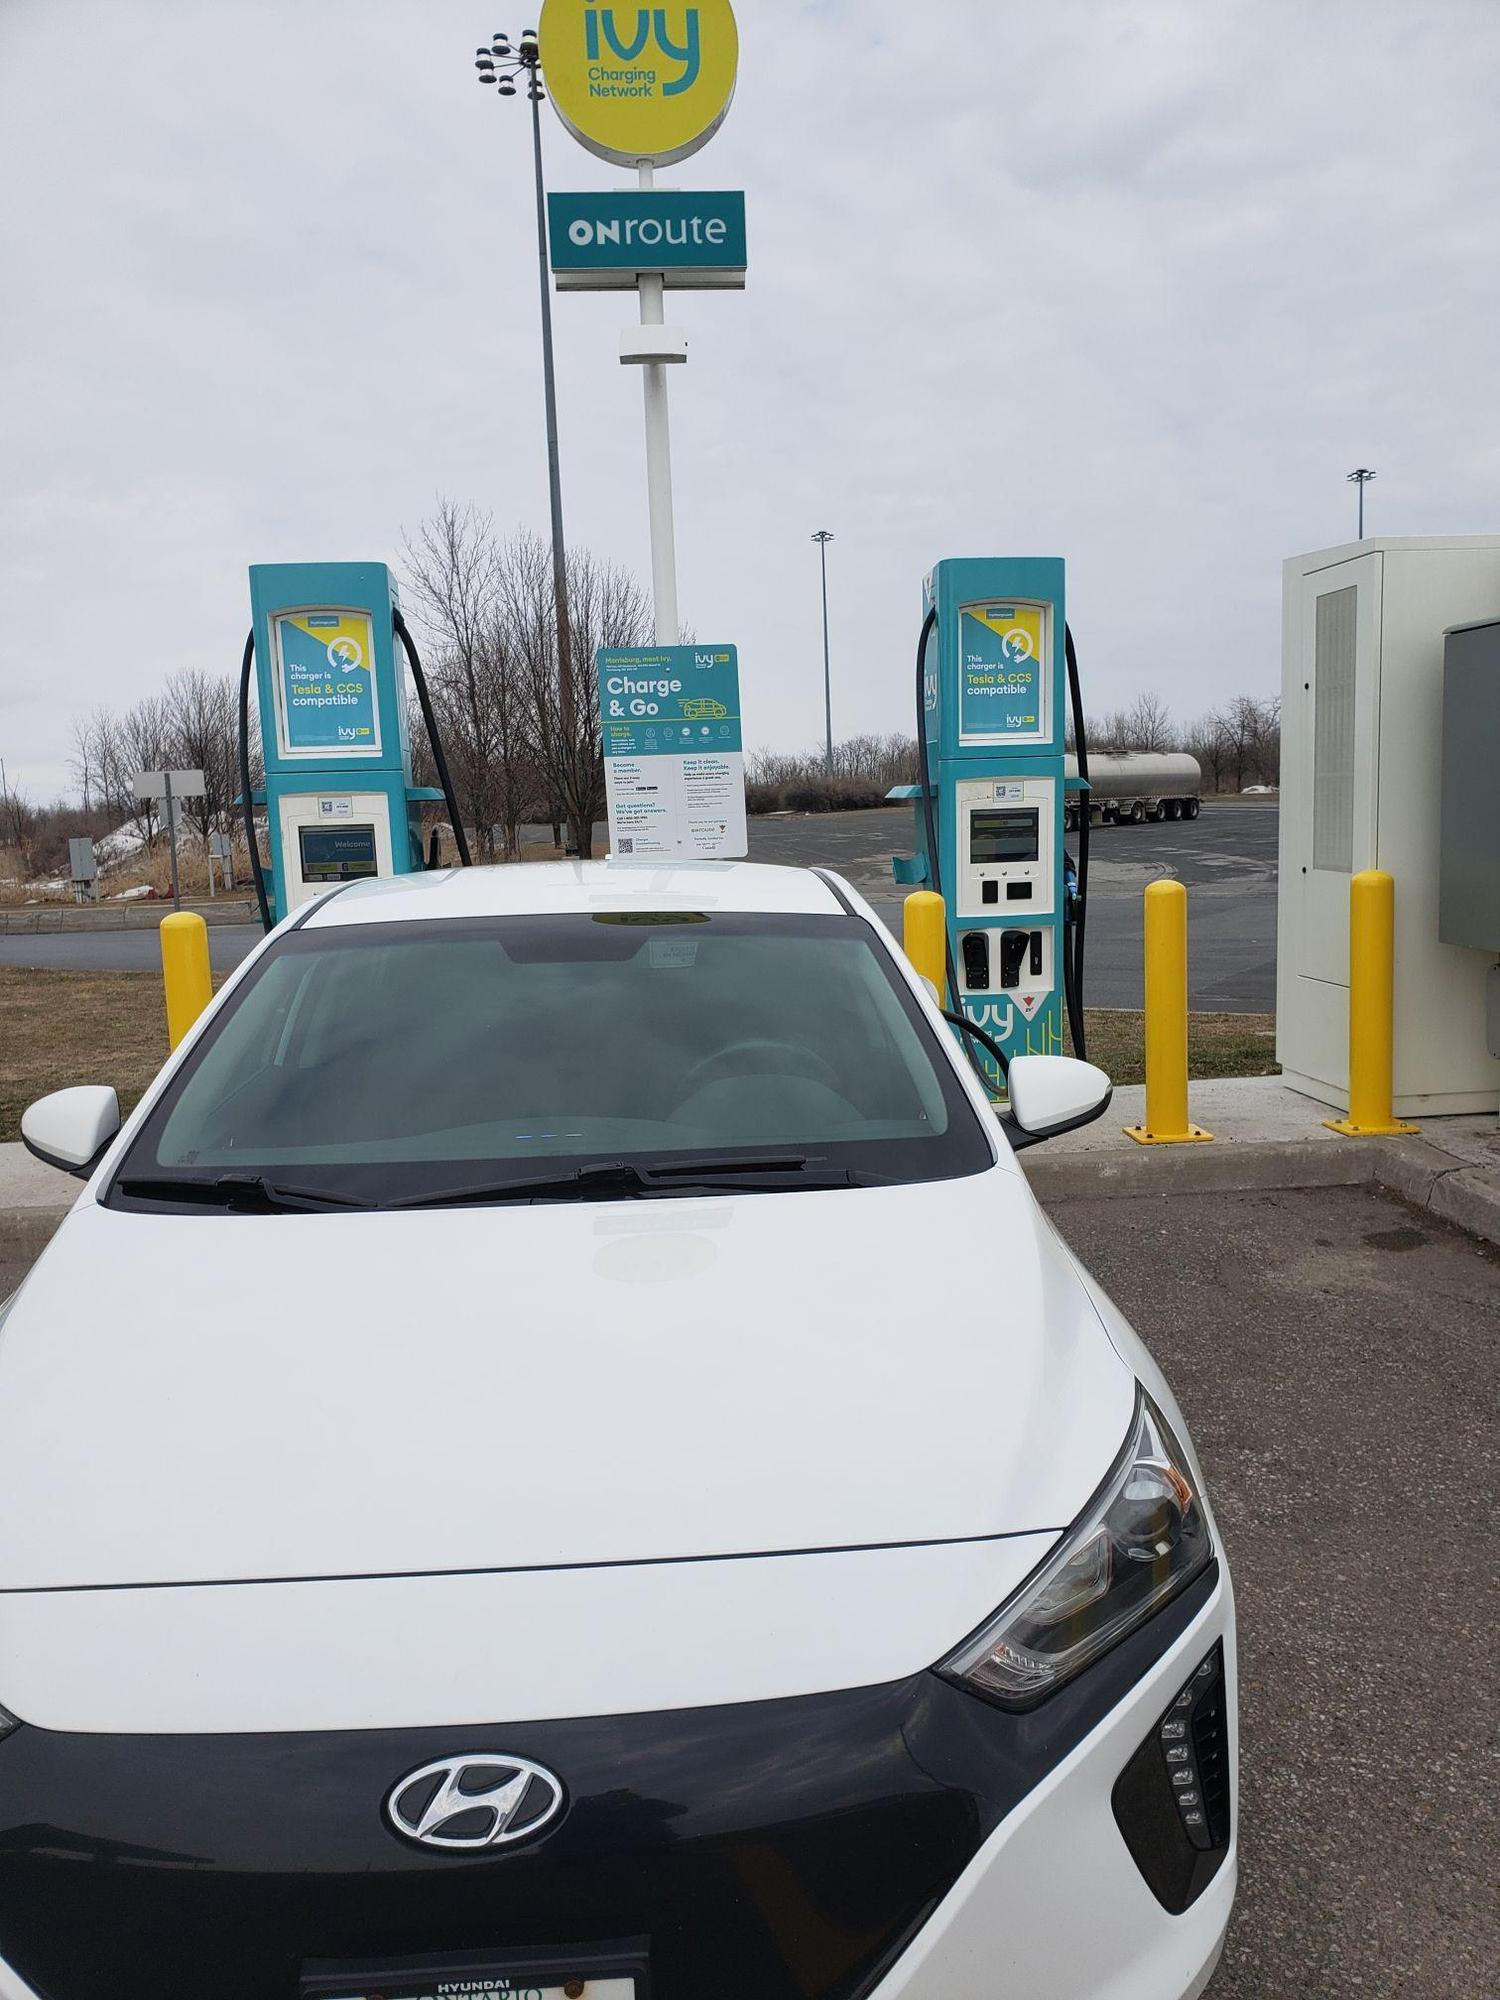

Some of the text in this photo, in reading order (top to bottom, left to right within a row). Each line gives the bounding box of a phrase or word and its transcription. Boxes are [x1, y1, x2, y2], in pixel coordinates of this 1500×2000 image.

[585, 0, 700, 97] ivy
[588, 67, 656, 84] Charging
[589, 83, 653, 97] Network
[694, 652, 714, 669] ivy
[967, 655, 982, 663] This
[967, 661, 1004, 671] charger is
[289, 664, 307, 673] This
[290, 670, 332, 681] charger is
[967, 673, 1032, 685] Tesla & CCS
[291, 683, 363, 695] Tesla & CCS
[606, 676, 682, 698] Charge
[967, 684, 1027, 697] compatible
[292, 694, 359, 708] compatible
[609, 698, 659, 717] & Go
[1006, 713, 1022, 728] ivy
[338, 726, 356, 740] ivy
[334, 840, 371, 848] Welcome
[437, 1979, 510, 1993] HYUNDAI
